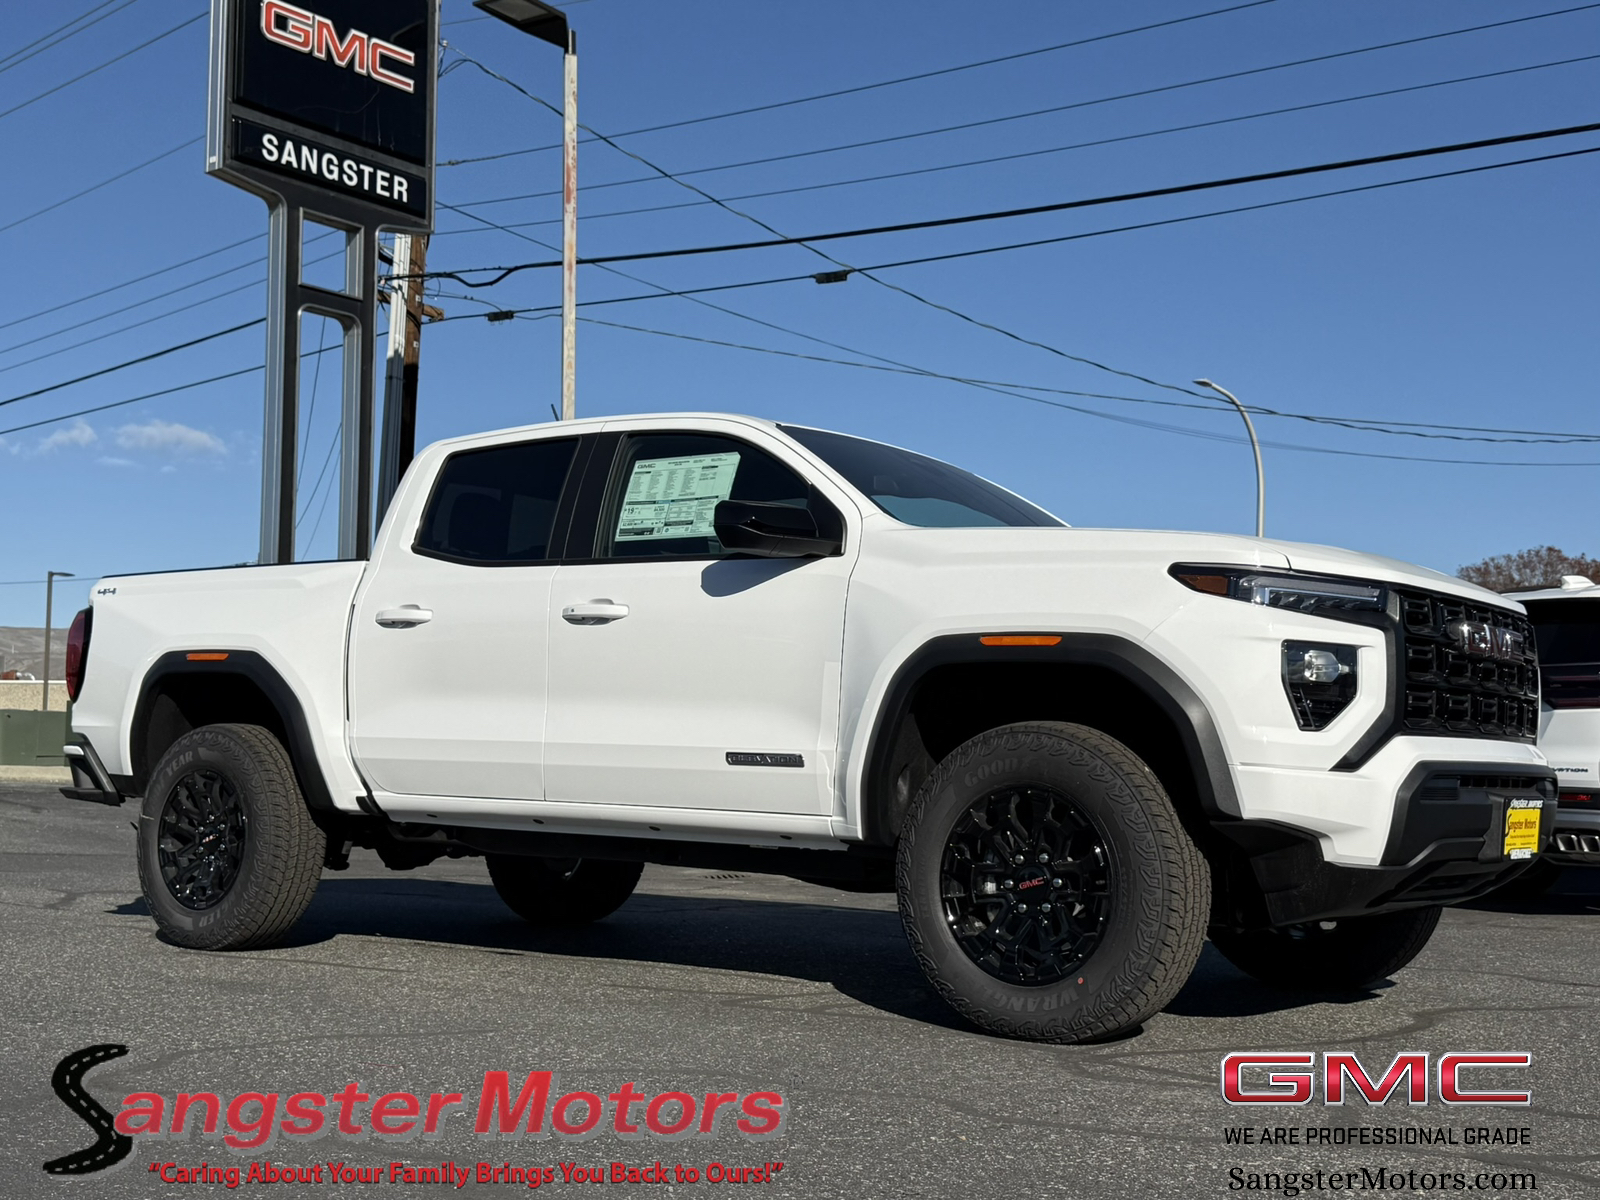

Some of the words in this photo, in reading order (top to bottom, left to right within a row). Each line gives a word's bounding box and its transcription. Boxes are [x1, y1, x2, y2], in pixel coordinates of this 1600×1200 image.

[261, 0, 415, 93] GMC
[262, 133, 408, 202] SANGSTER
[1019, 876, 1045, 890] GMC
